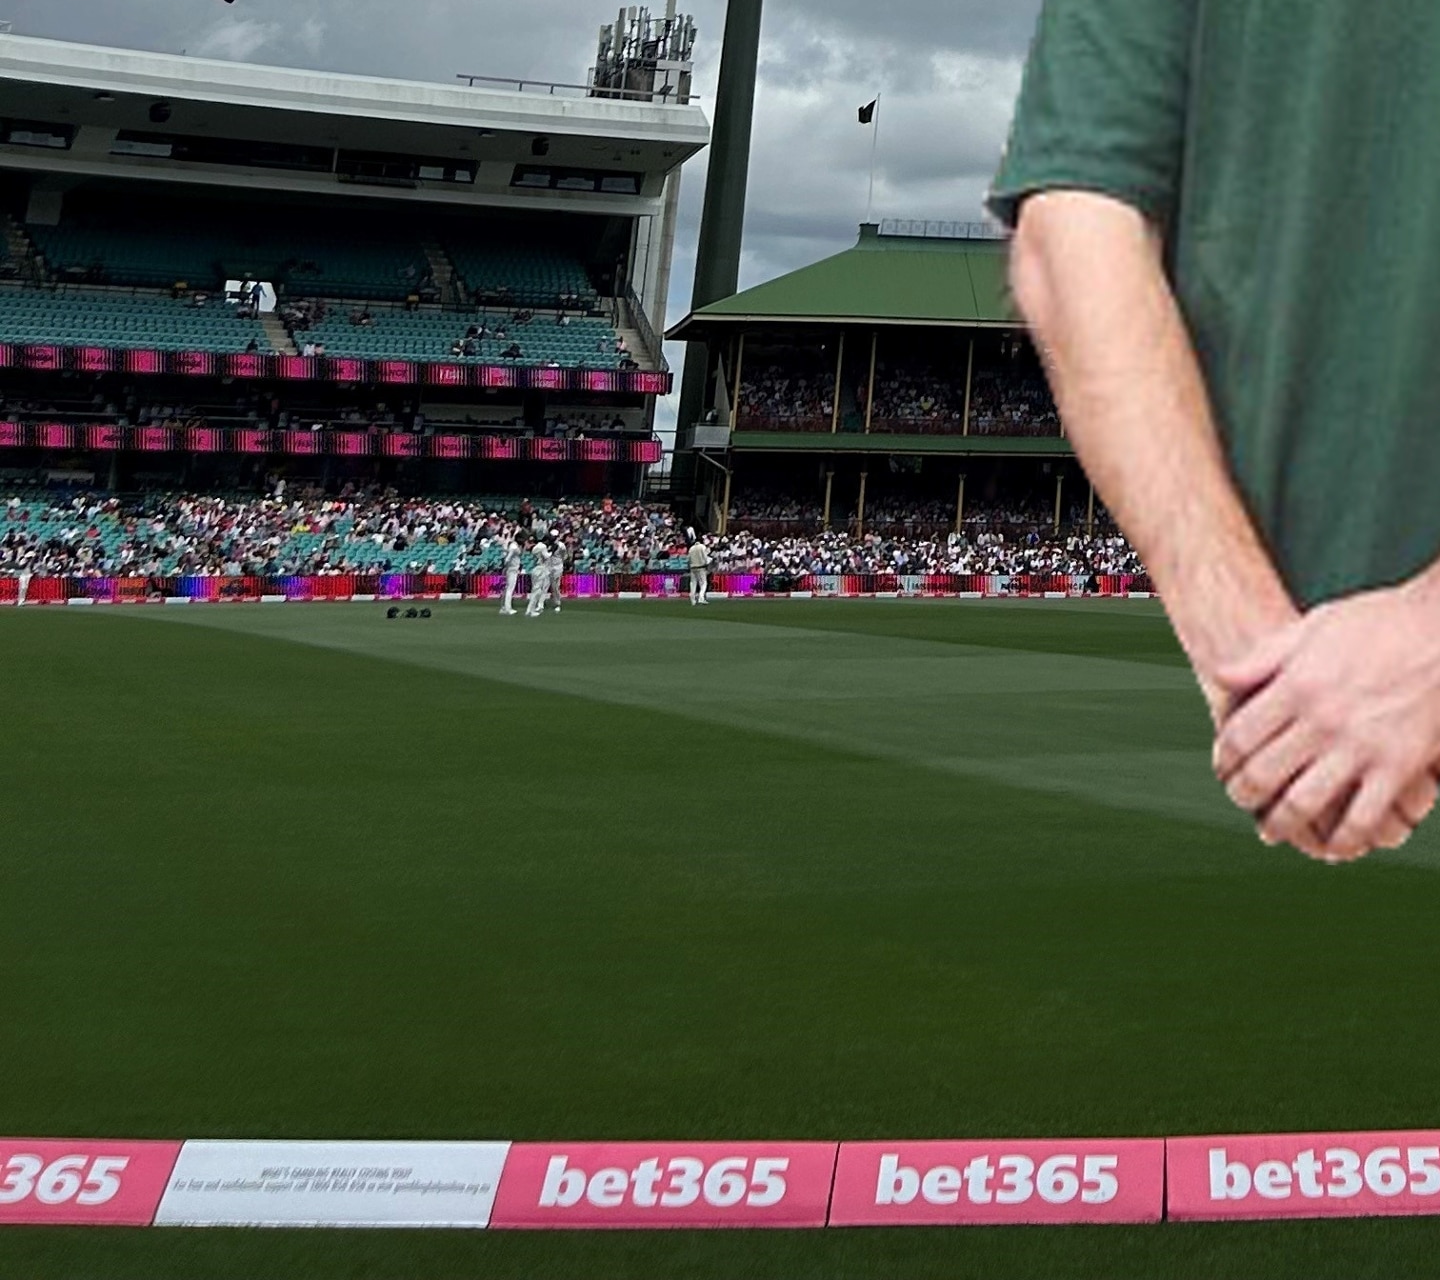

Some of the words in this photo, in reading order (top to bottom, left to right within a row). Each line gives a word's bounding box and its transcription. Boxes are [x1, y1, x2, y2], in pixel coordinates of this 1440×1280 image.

[0, 1153, 130, 1206] 365
[538, 1155, 790, 1207] bet365
[874, 1154, 1119, 1205] bet365
